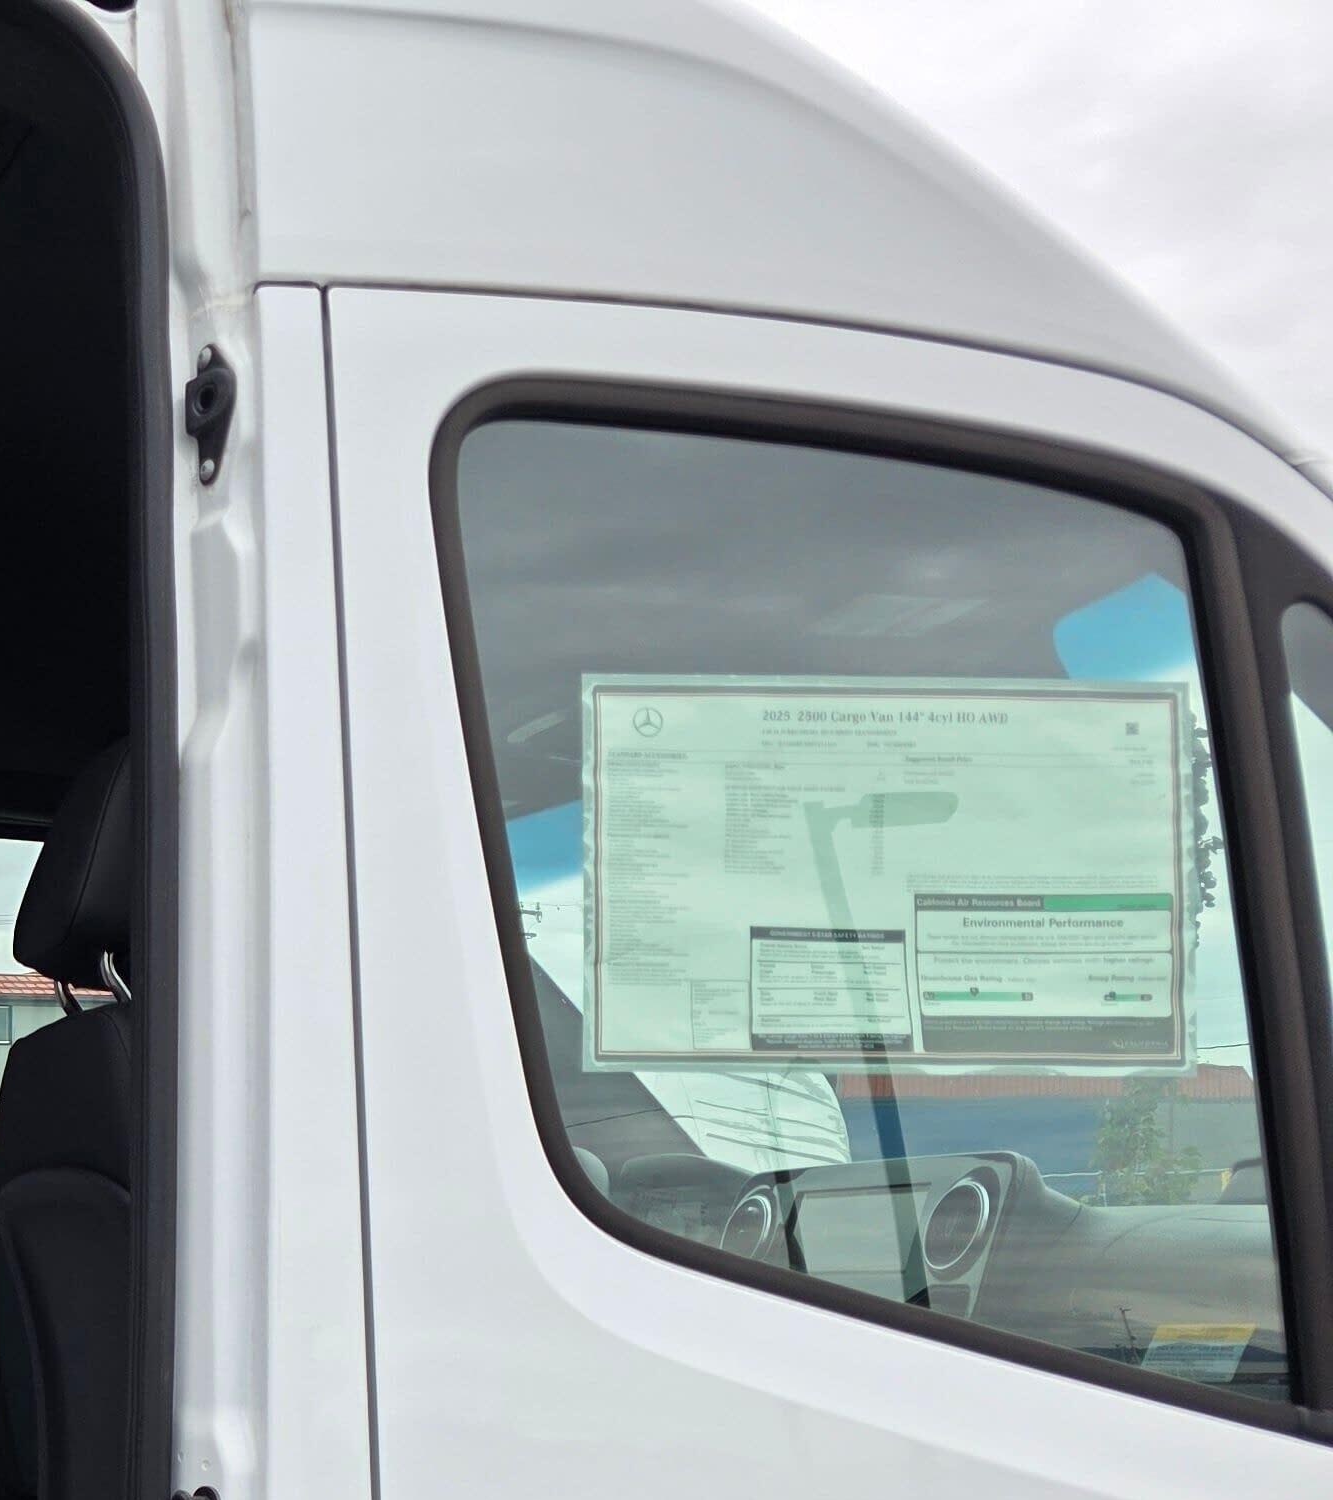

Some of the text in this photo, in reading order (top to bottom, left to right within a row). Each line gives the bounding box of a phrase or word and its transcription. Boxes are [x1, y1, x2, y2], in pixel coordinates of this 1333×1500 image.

[762, 710, 791, 722] 2025
[830, 710, 867, 725] Cargo
[870, 710, 894, 723] Van
[928, 711, 953, 725] 4cyl
[978, 712, 1009, 724] AWD
[916, 898, 1042, 908] California Air Resources Board
[962, 917, 1124, 929] Environmental Performance
